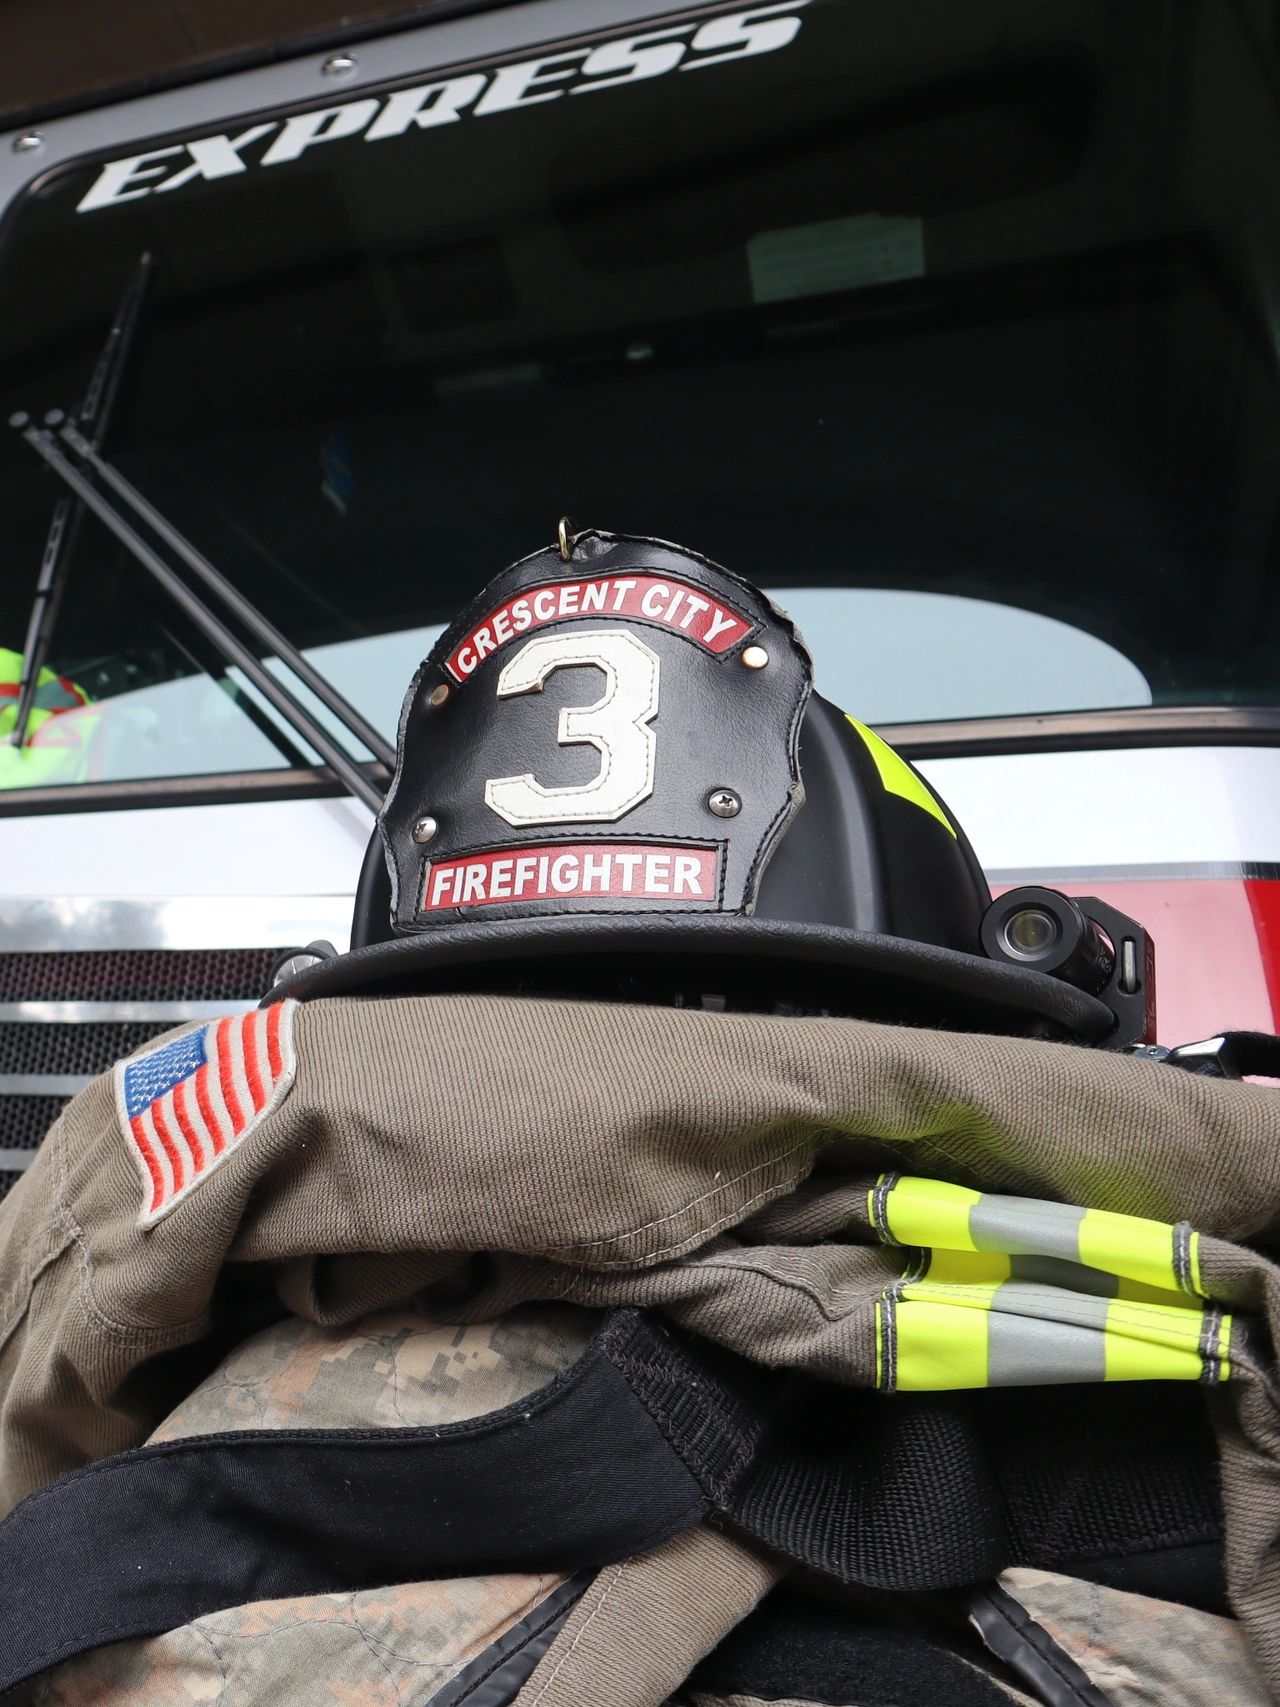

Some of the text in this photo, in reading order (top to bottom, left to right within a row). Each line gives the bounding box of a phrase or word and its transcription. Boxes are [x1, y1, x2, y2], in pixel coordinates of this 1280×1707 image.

[75, 0, 812, 213] EXPRESS
[456, 580, 737, 675] CRESCENT CITY
[485, 629, 661, 829] 3
[431, 854, 703, 906] FIREFIGHTER
